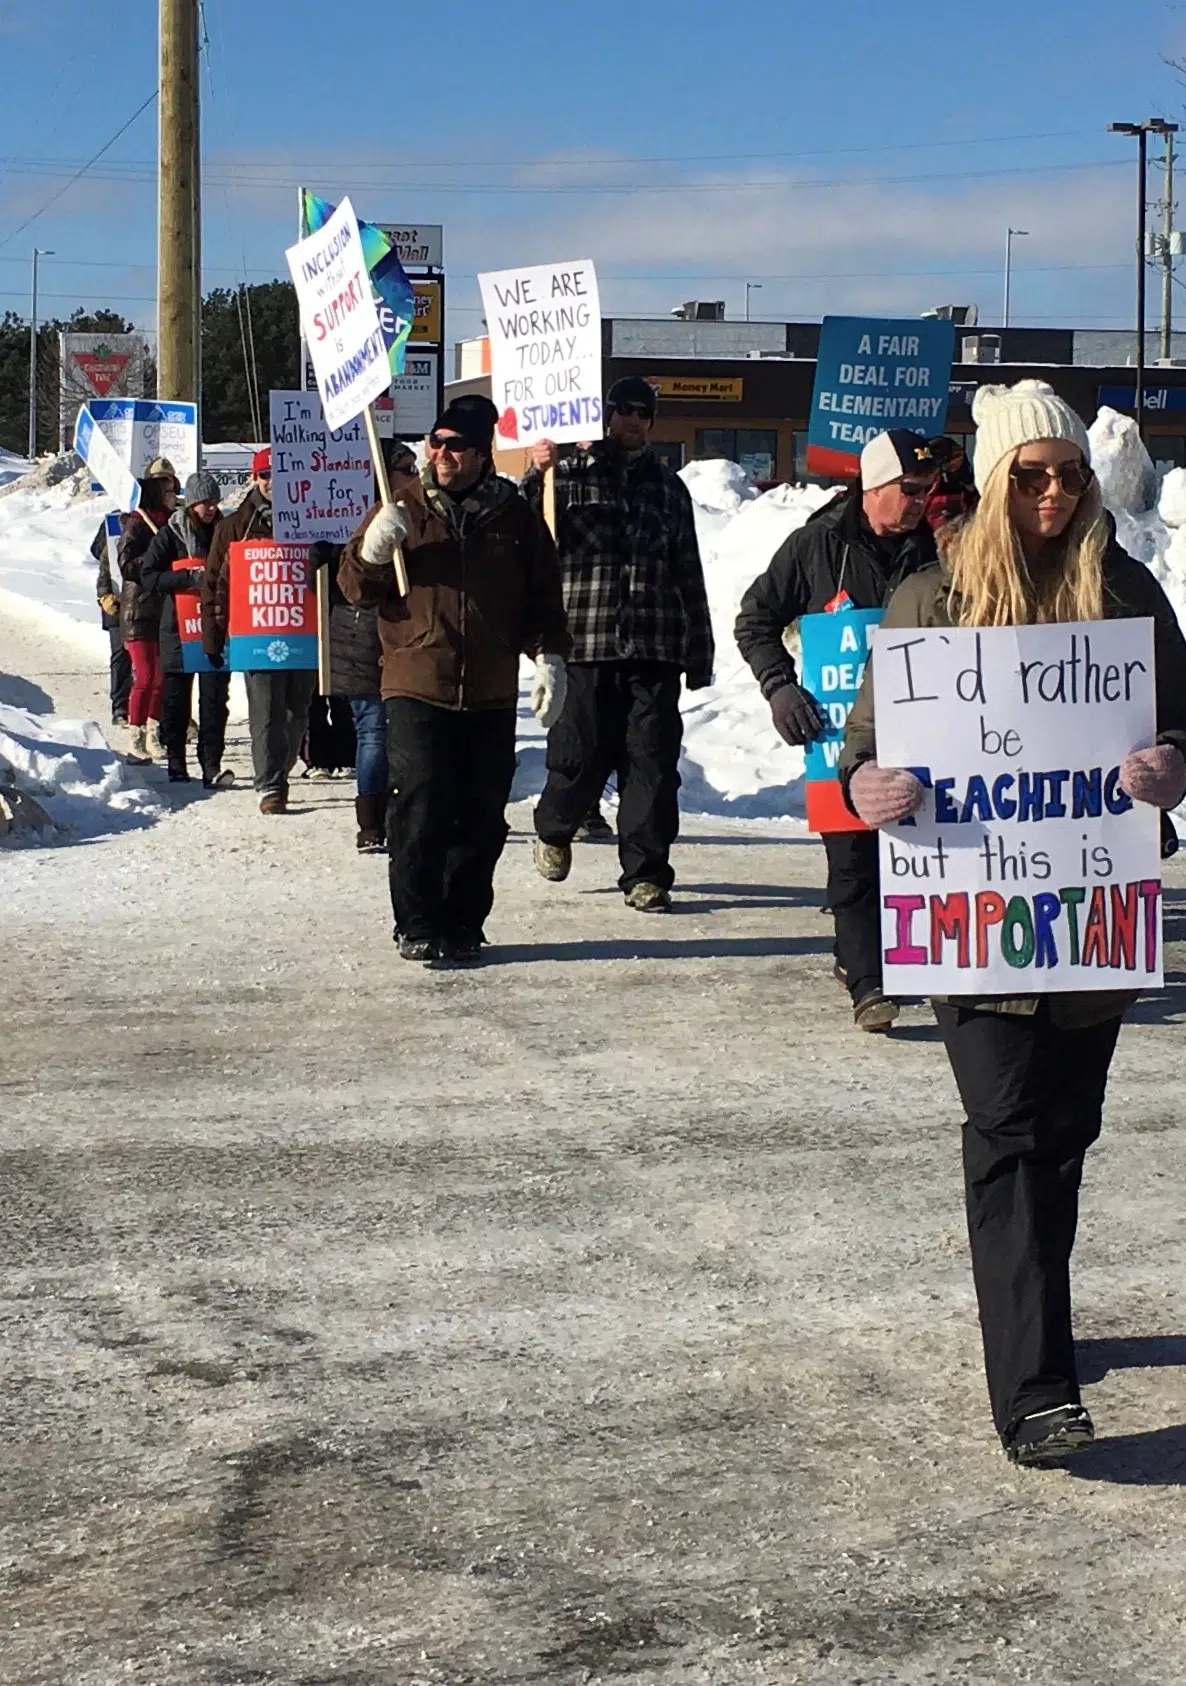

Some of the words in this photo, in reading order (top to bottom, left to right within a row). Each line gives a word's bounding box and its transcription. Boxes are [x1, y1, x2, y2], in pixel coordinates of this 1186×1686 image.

[301, 221, 351, 282] INCLUSION
[494, 279, 537, 307] WE
[551, 271, 588, 298] ARE
[313, 270, 363, 341] SUPPORT
[498, 302, 591, 340] WORKING
[857, 334, 872, 355] A
[877, 335, 920, 357] FAIR
[504, 376, 534, 405] FOR
[545, 365, 581, 396] OUR
[838, 363, 889, 387] DEAL
[893, 366, 930, 387] FOR
[284, 401, 311, 421] I'm
[522, 396, 601, 431] STUDENTS
[818, 391, 943, 418] ELEMENTARY
[273, 424, 326, 451] Walking
[277, 452, 305, 473] I'm
[310, 450, 371, 478] Standing
[287, 480, 312, 504] UP
[328, 478, 354, 500] for
[278, 510, 301, 529] my
[244, 548, 311, 560] EDUCATION
[250, 561, 305, 583] CUTS
[248, 584, 308, 605] HURT
[252, 606, 304, 627] KIDS
[840, 625, 858, 653] A
[887, 631, 987, 704] I'd
[1018, 634, 1147, 704] rather
[980, 715, 1023, 757] be
[889, 836, 949, 878] but
[979, 834, 1052, 881] this
[1082, 834, 1113, 877] is
[884, 879, 1162, 973] IMPORTANT
